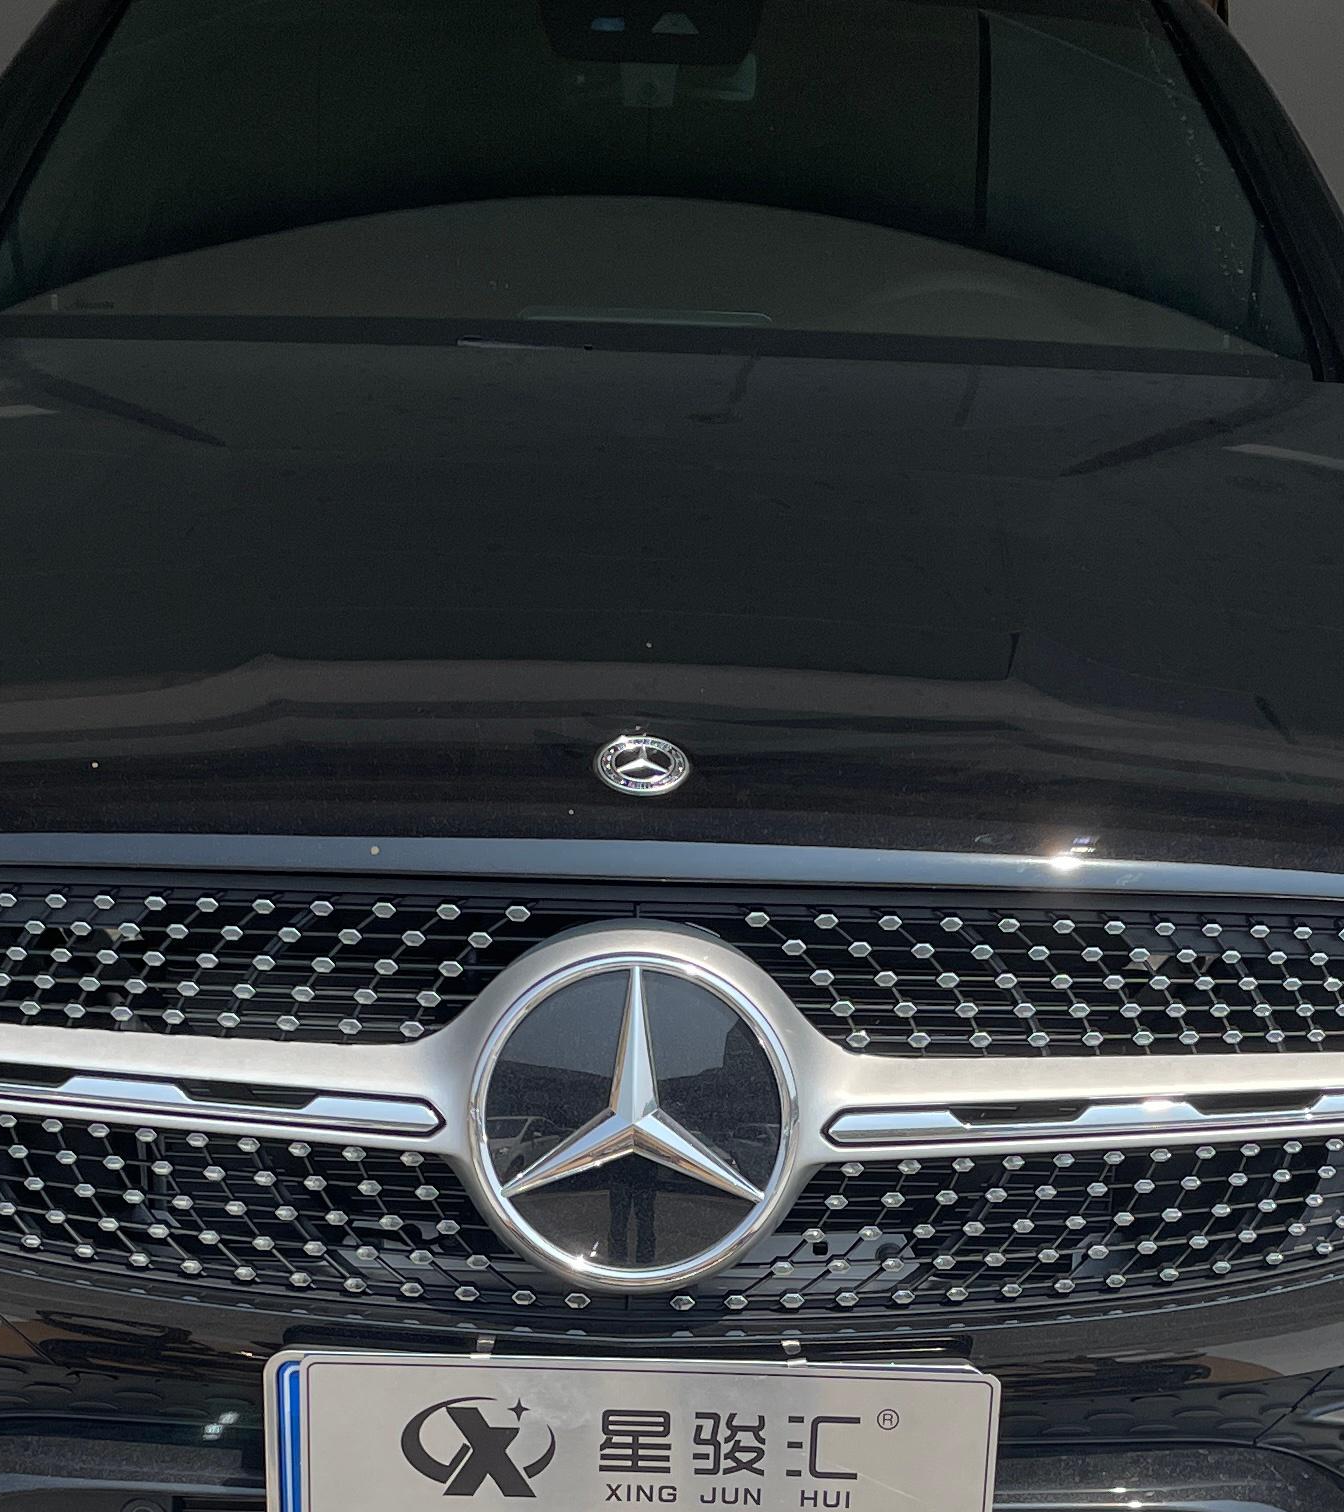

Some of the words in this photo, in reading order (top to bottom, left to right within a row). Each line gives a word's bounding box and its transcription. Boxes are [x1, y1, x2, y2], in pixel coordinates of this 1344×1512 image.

[599, 1409, 860, 1480] 星骏汇
[605, 1484, 678, 1503] XING
[700, 1487, 762, 1506] JUN
[799, 1490, 851, 1508] HUI
